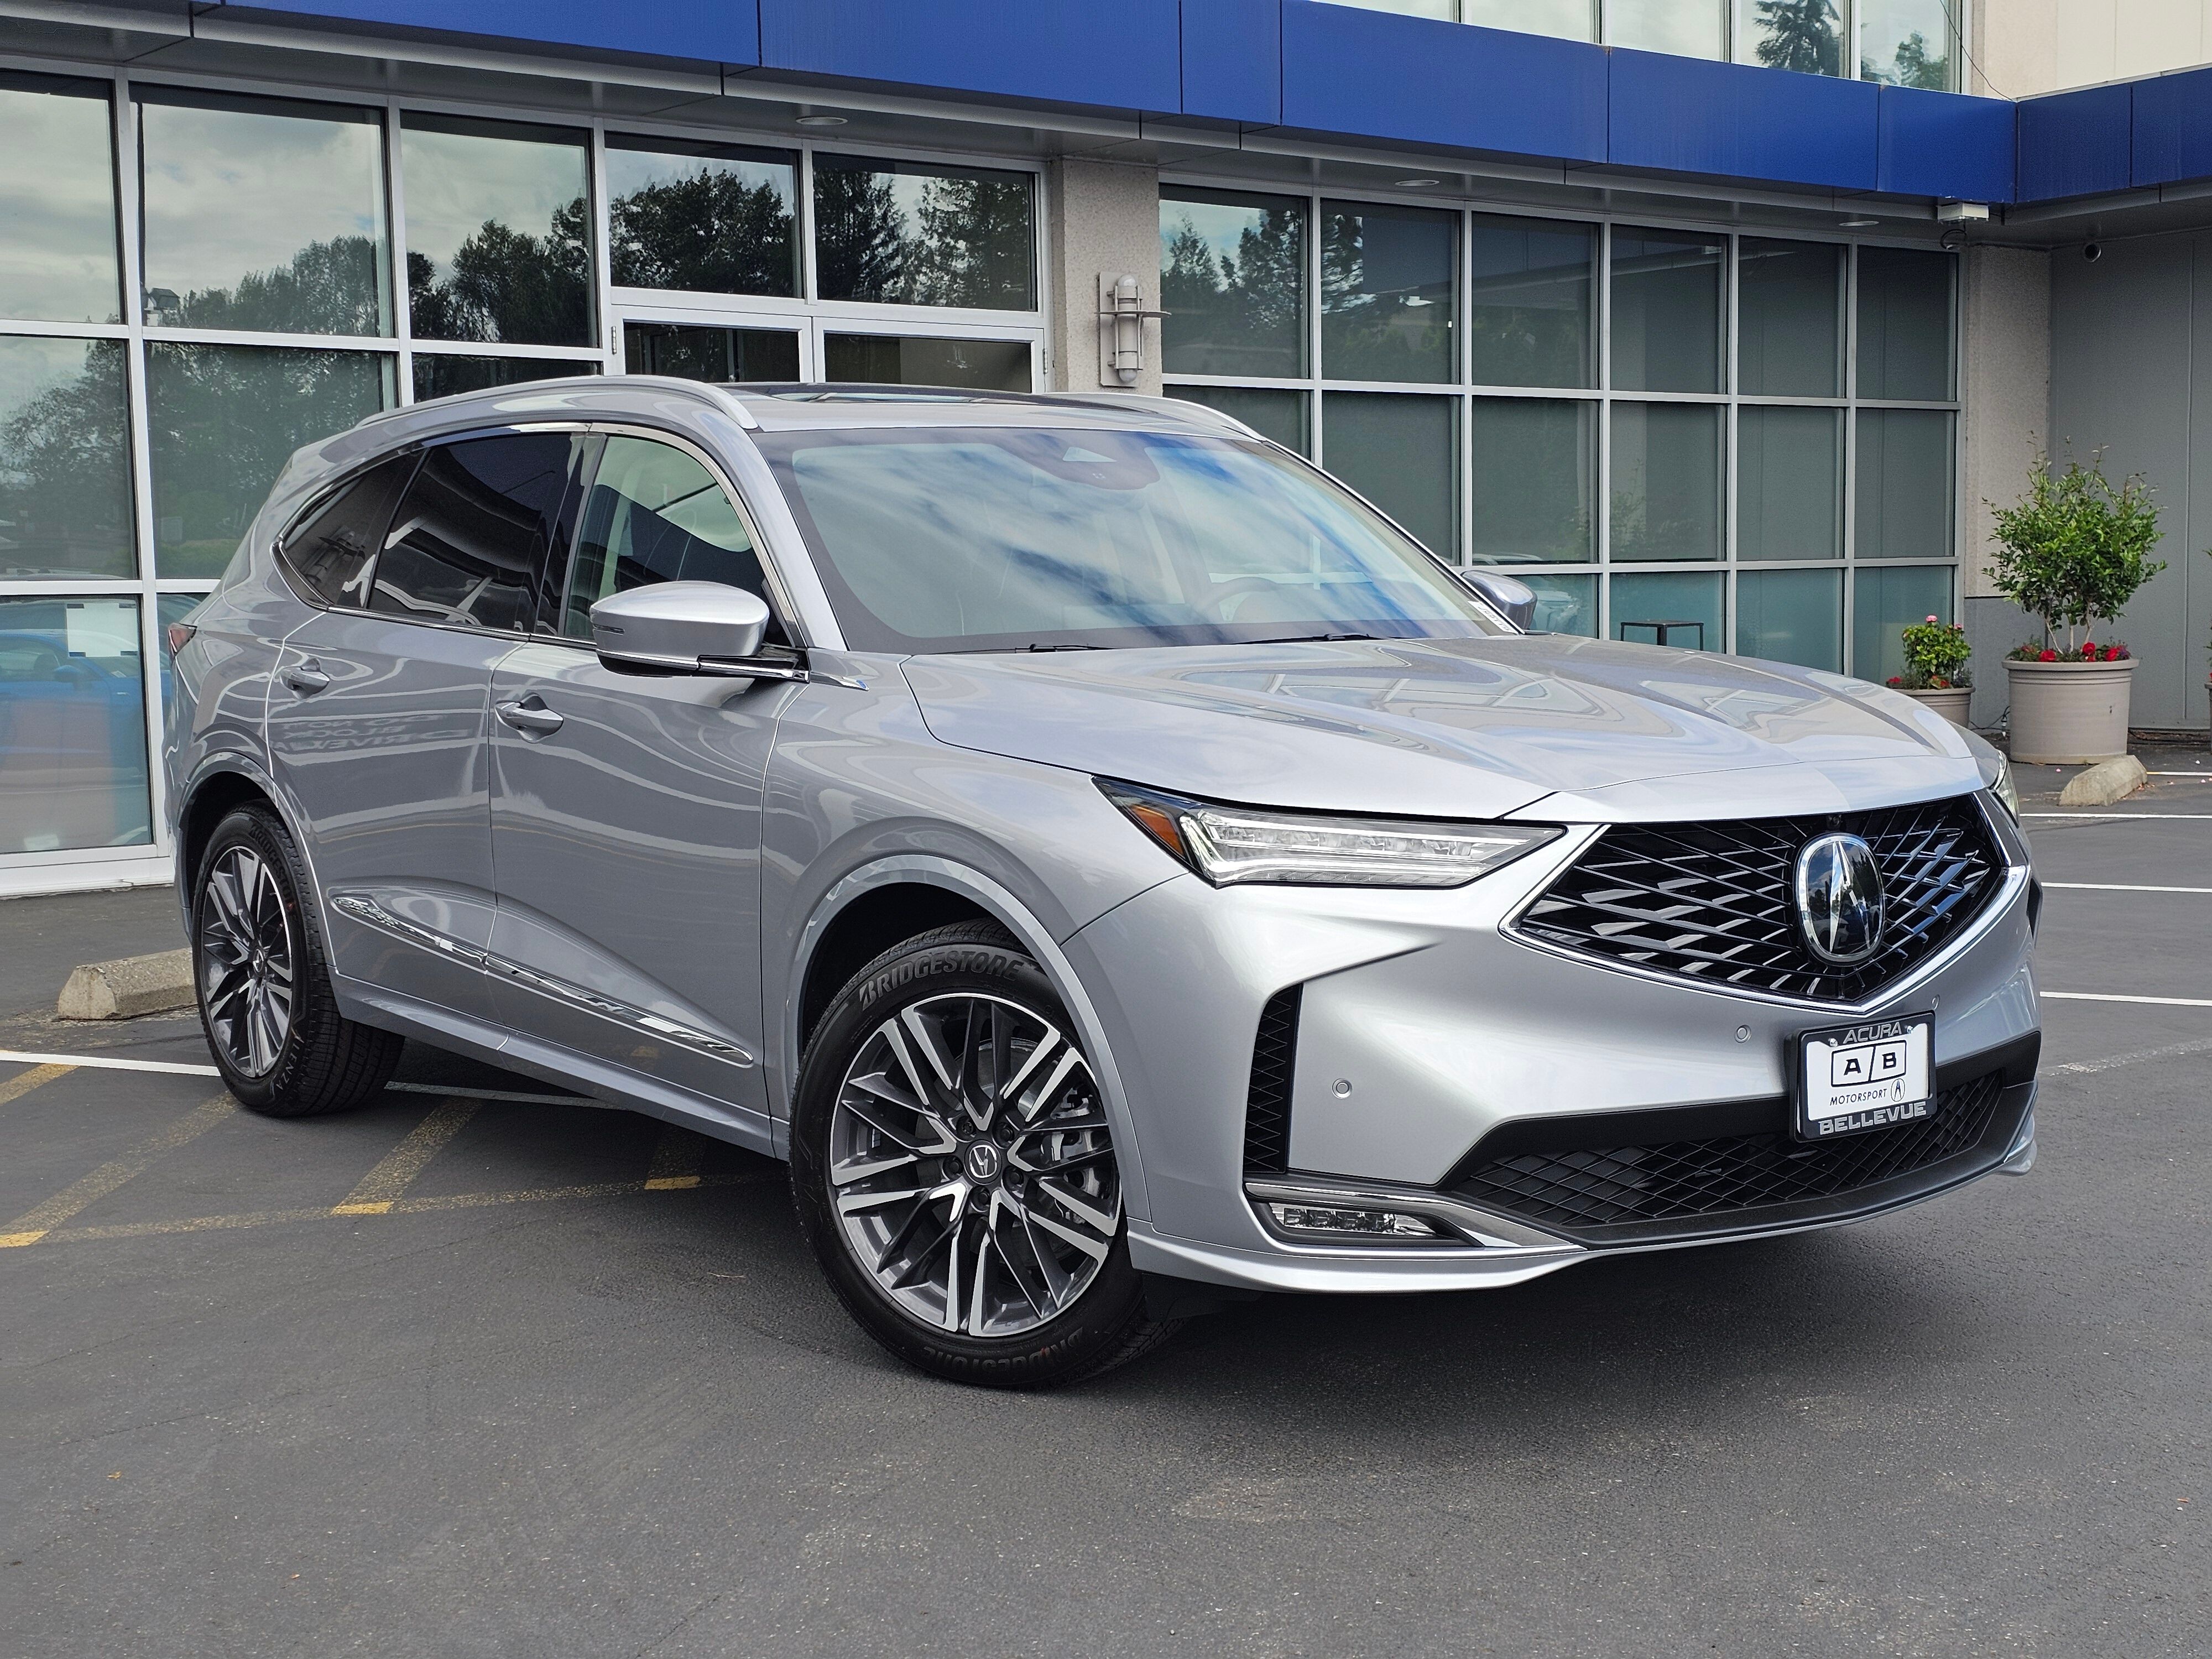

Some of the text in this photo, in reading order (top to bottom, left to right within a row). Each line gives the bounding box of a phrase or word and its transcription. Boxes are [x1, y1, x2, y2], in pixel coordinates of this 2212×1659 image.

[859, 950, 1025, 1011] BRIDGESTONE
[1843, 1022, 1902, 1044] ACURA
[1844, 1052, 1896, 1076] A B
[1829, 1088, 1887, 1105] MOTORSPORT
[1819, 1101, 1927, 1135] BELLEVUE
